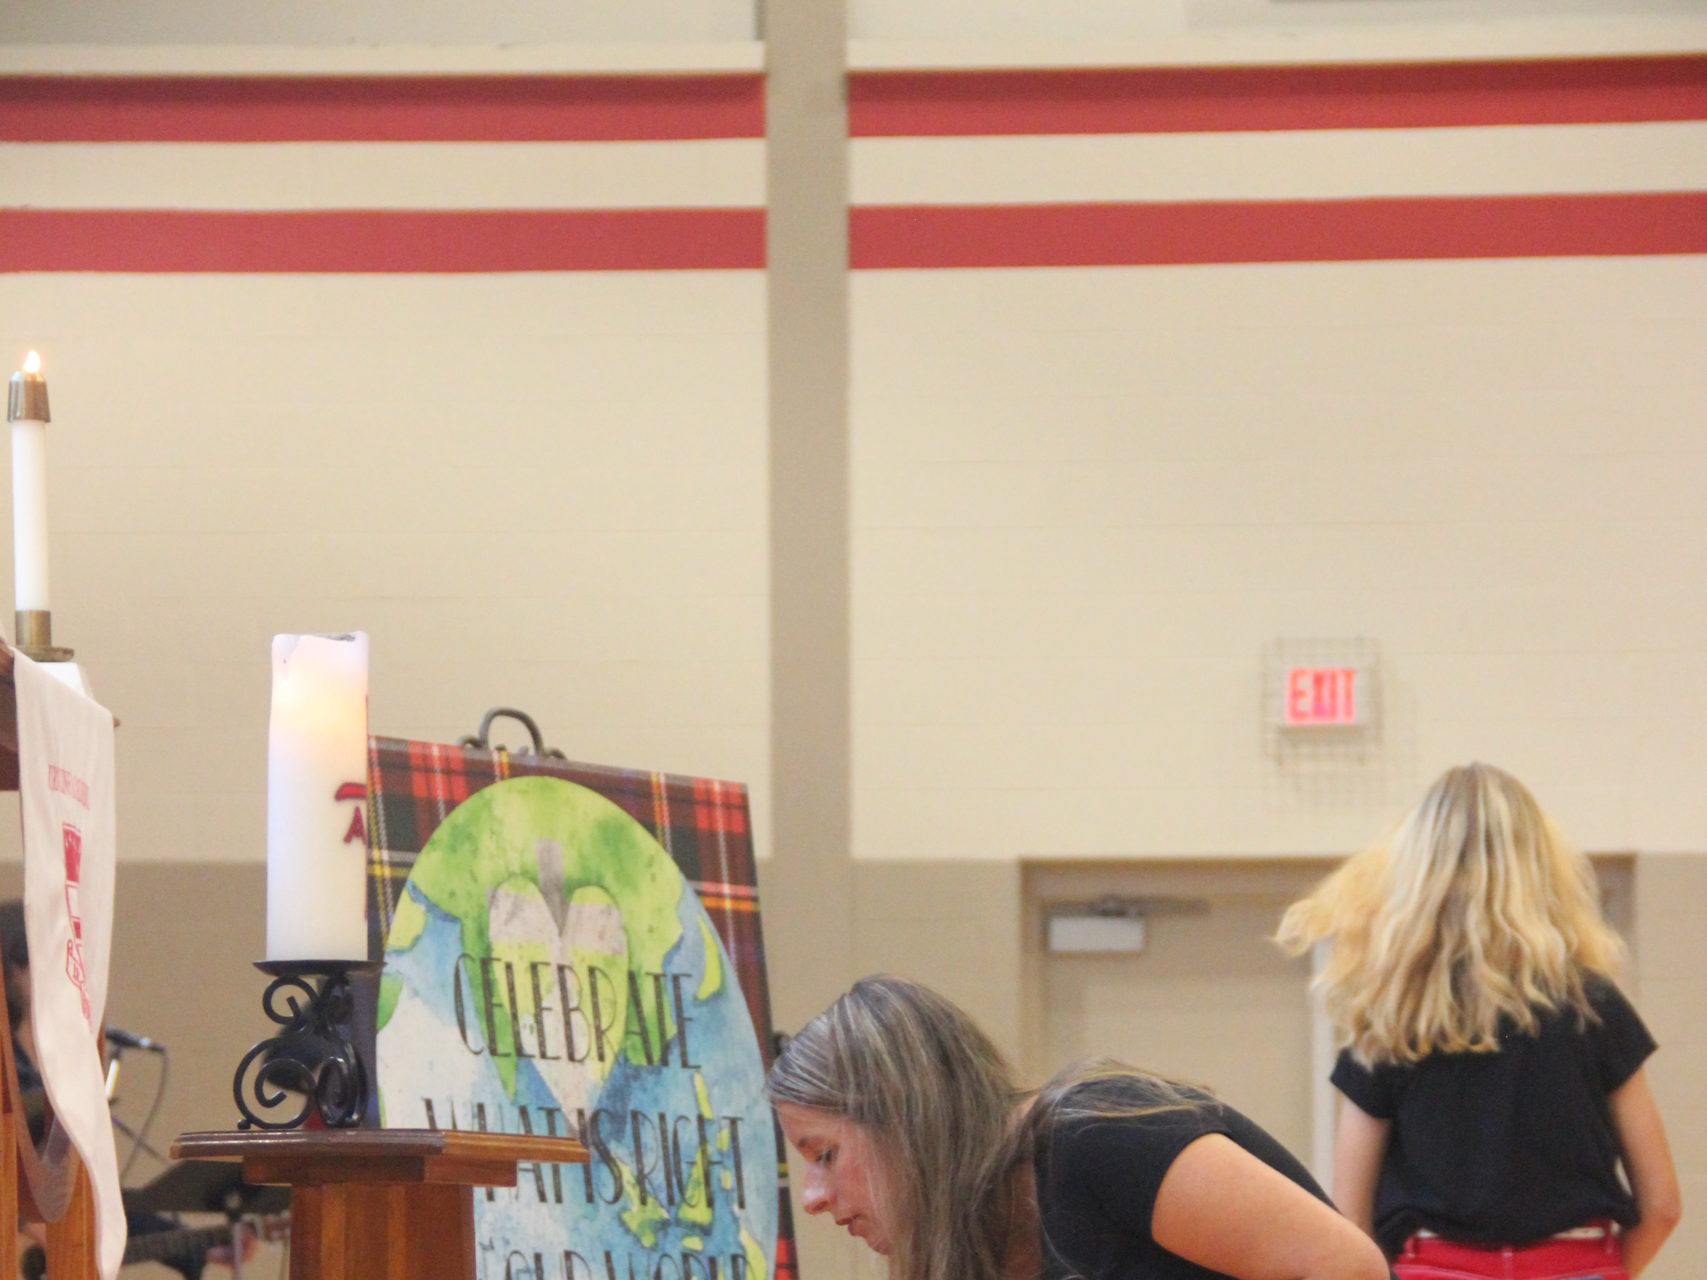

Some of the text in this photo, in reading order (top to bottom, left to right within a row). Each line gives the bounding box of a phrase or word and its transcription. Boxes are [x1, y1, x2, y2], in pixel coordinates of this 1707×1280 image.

[1287, 666, 1356, 722] EXIT
[454, 954, 702, 1070] CELEBRATE
[576, 1107, 623, 1205] IS
[631, 1109, 746, 1210] RIGHT
